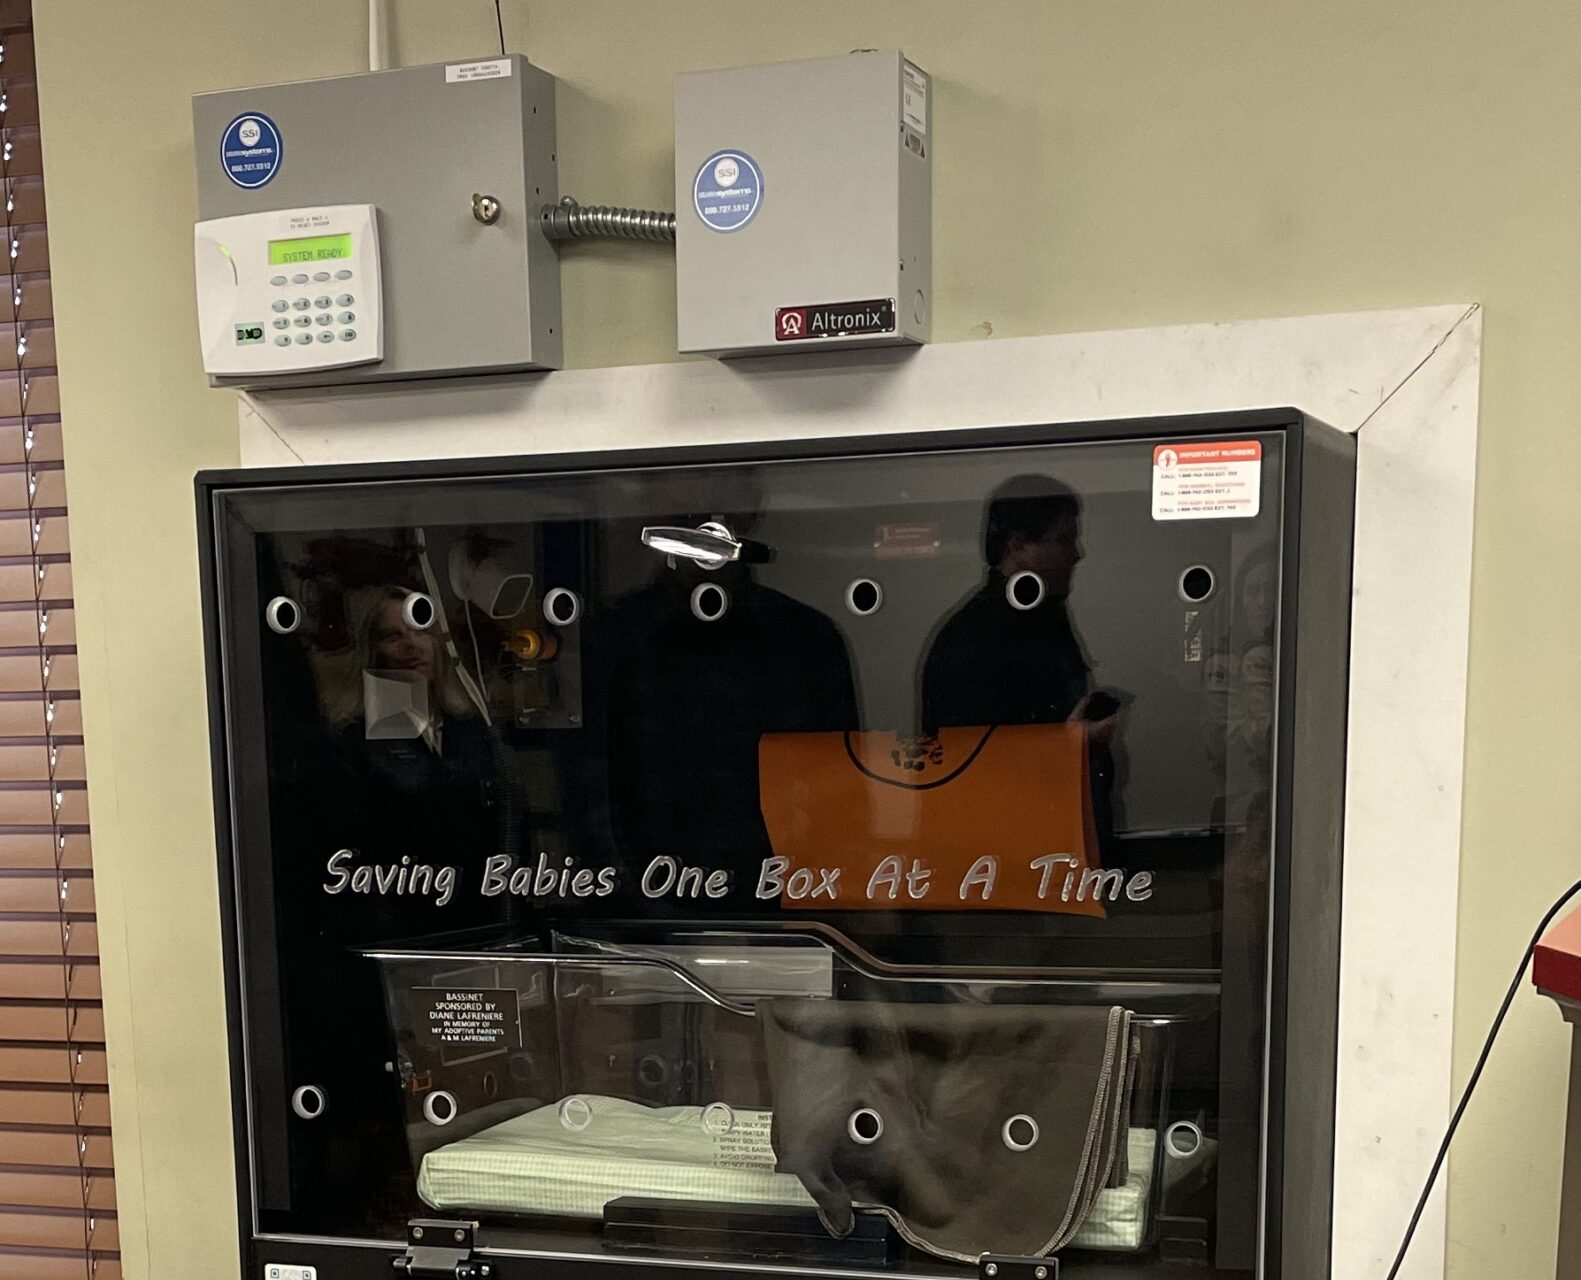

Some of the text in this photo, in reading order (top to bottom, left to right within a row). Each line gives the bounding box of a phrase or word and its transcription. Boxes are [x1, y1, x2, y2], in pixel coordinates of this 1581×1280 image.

[242, 129, 258, 138] SSI
[718, 168, 735, 177] SSI
[283, 248, 342, 263] SYSTEM READY
[812, 308, 881, 331] Altronix
[322, 849, 1153, 906] Saving Babies One Box At A Time
[446, 993, 483, 1001] BASSINET
[436, 1002, 496, 1011] SPONSORED BY
[429, 1011, 503, 1020] DIANE LAFRENIERE
